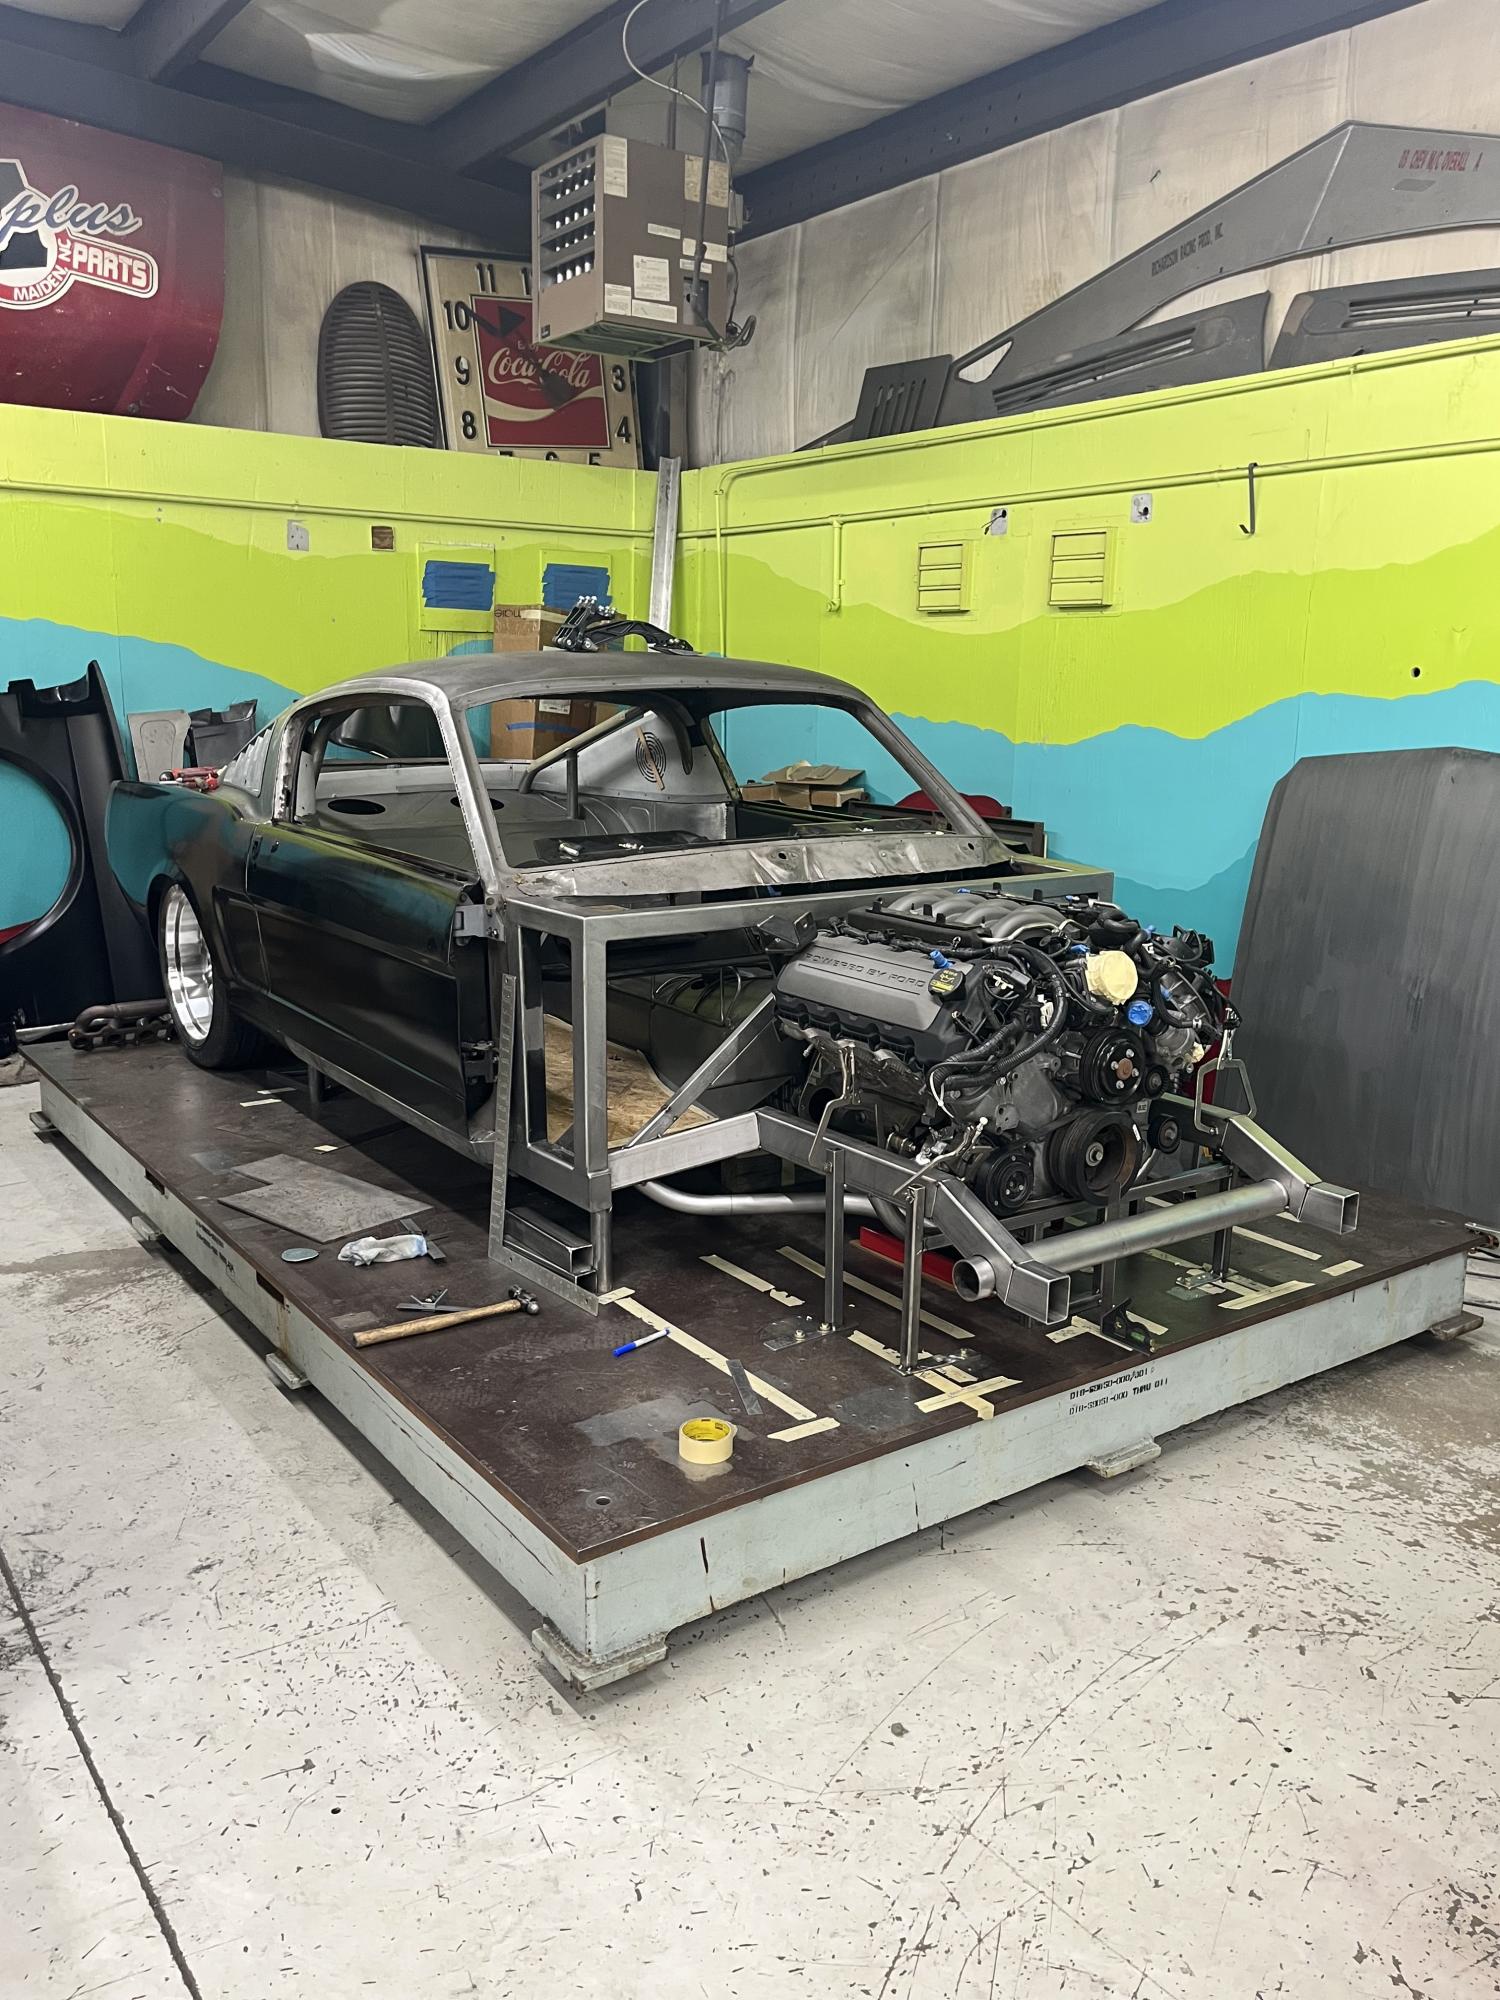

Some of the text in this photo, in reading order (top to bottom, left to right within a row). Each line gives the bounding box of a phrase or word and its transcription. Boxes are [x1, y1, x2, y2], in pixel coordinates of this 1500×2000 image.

[1180, 237, 1197, 261] RACING
[72, 242, 147, 288] PARTS
[475, 262, 496, 293] 11
[443, 300, 471, 332] 10
[455, 355, 470, 386] 9
[611, 364, 626, 393] 3
[461, 410, 477, 440] 8
[615, 415, 631, 444] 4
[805, 952, 864, 973] POWERED
[867, 967, 887, 977] BY
[888, 973, 927, 988] FORD
[1133, 1382, 1152, 1396] THRU
